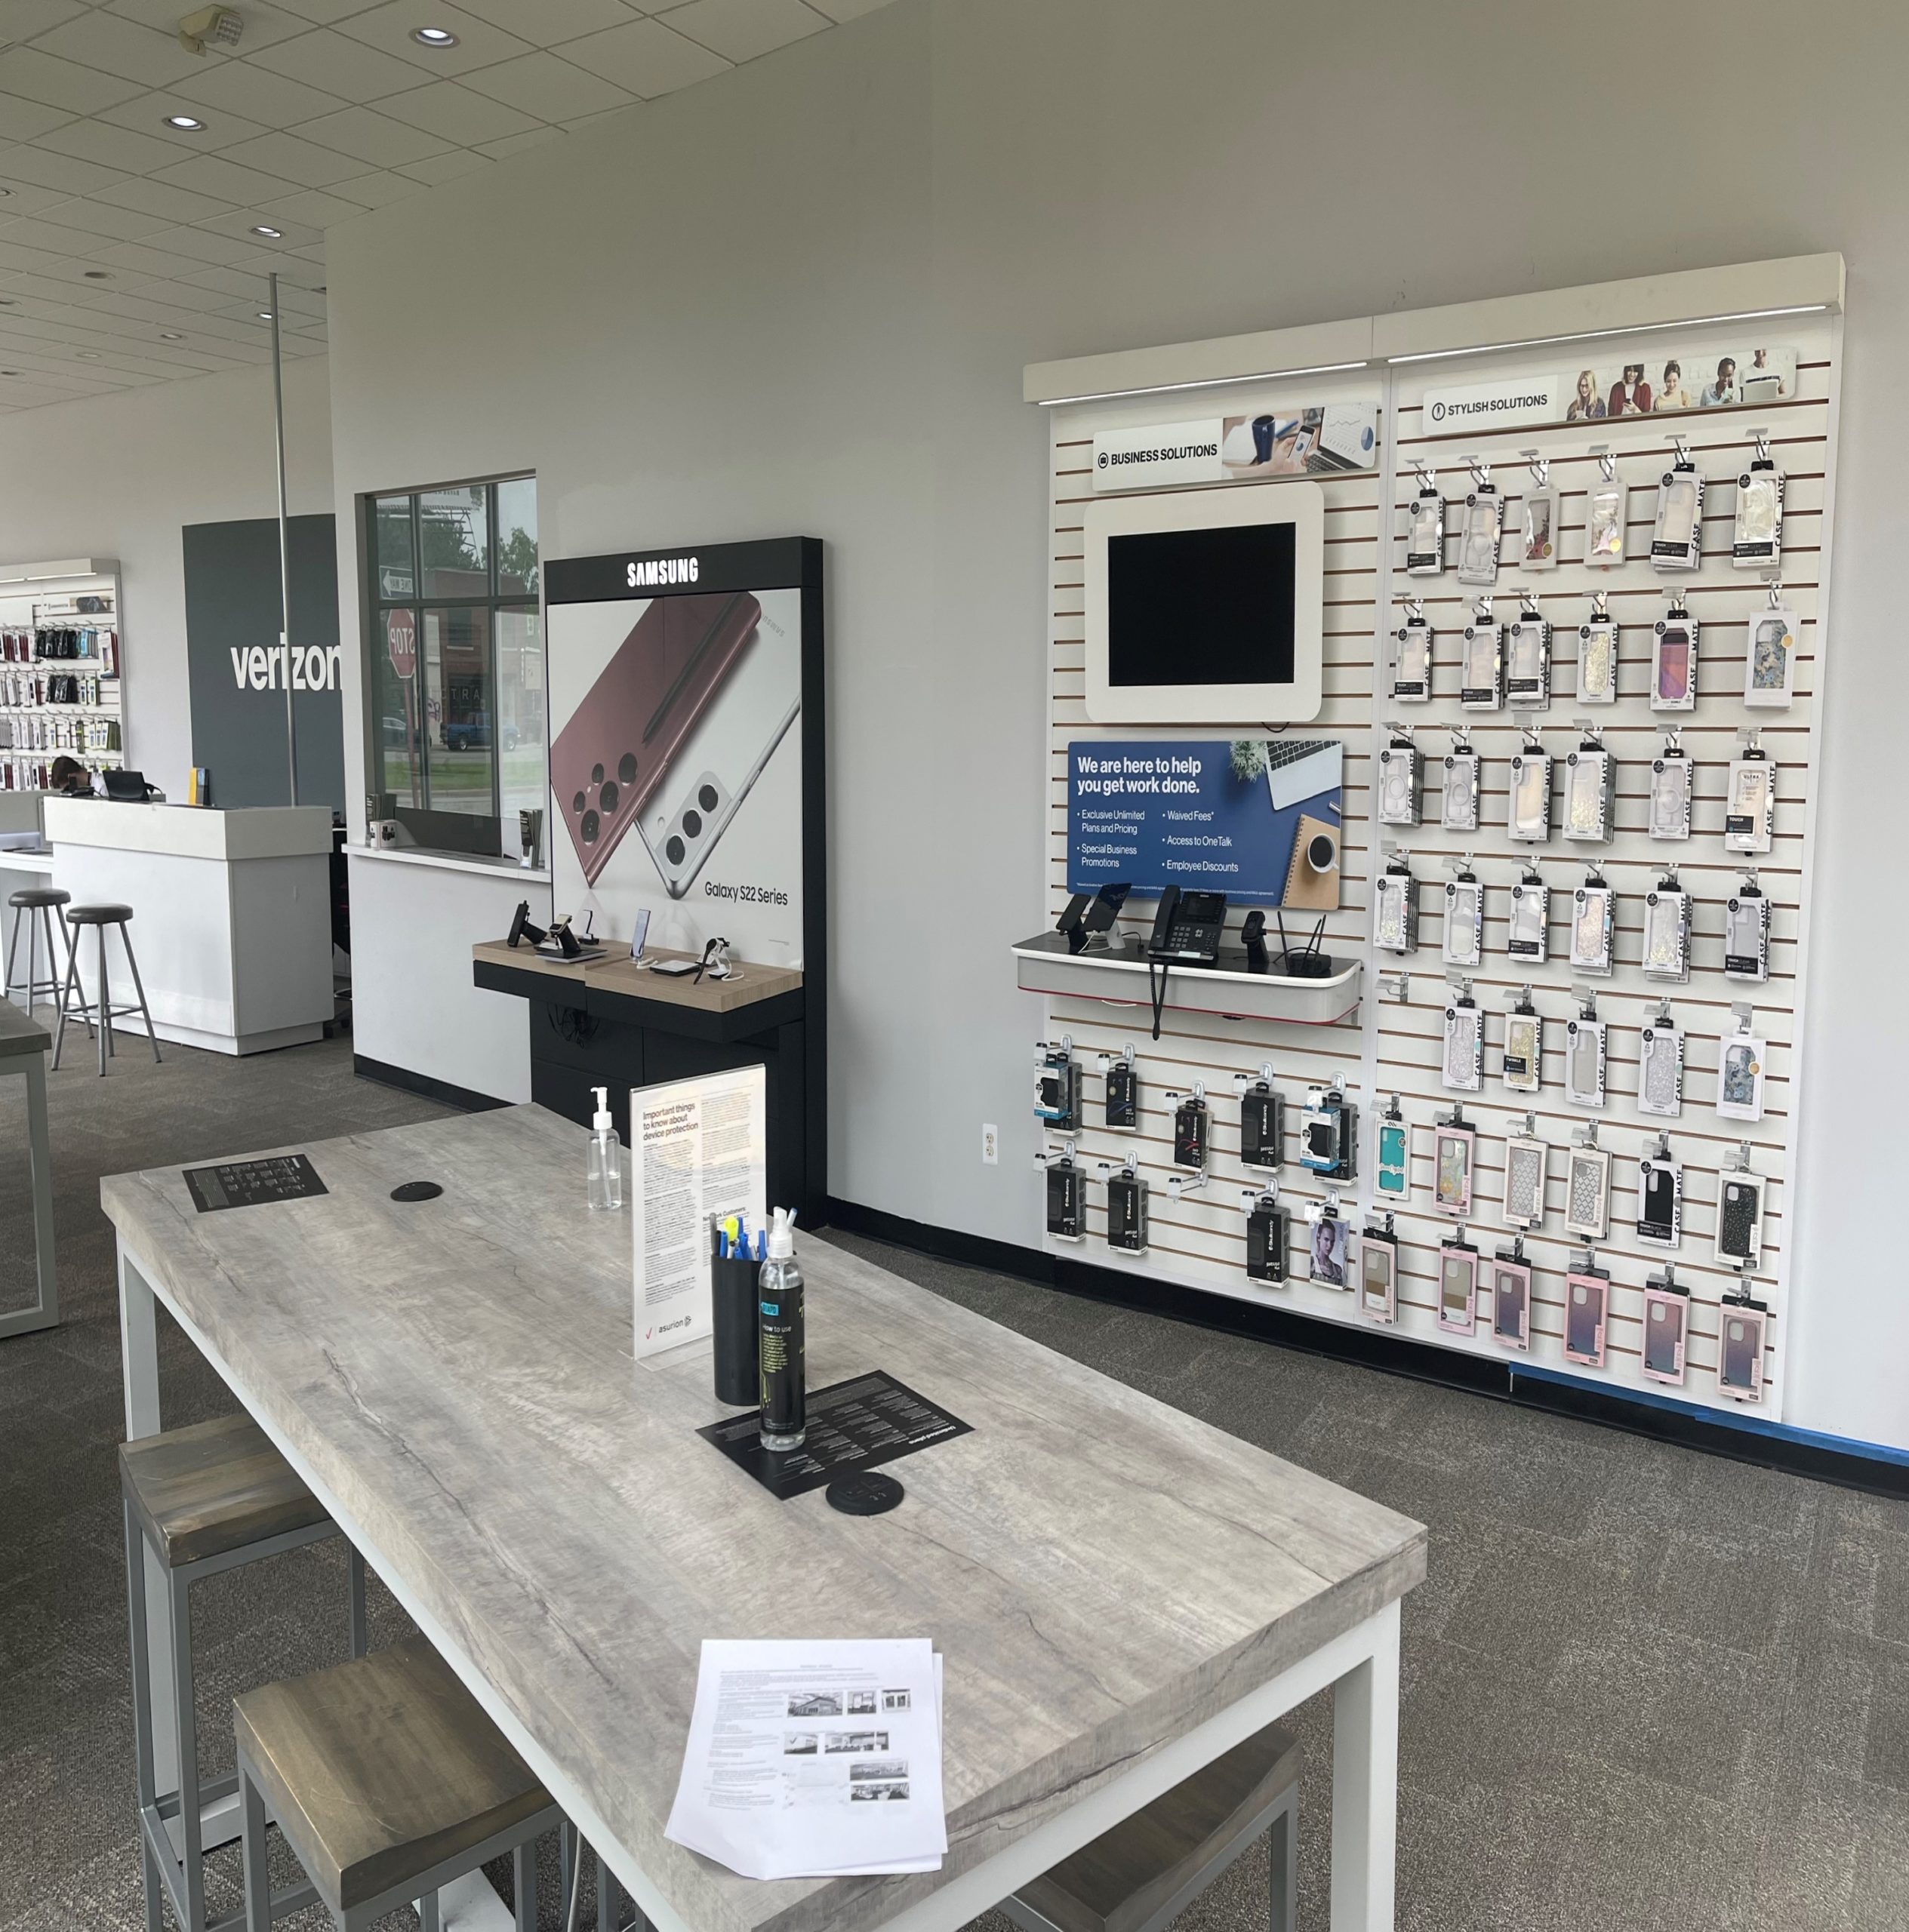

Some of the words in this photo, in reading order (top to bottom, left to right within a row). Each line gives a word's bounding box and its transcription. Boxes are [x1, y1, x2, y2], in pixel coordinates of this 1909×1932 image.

[1448, 401, 1489, 416] STYLISH
[1490, 394, 1547, 411] SOLUTIONS
[1111, 450, 1159, 466] BUSINESS
[1160, 444, 1218, 460] SOLUTIONS
[1778, 475, 1786, 503] MATE
[1691, 523, 1699, 550] CASE
[1697, 478, 1705, 507] MATE
[627, 557, 698, 587] SAMSUNG
[230, 632, 343, 691] verizon
[1077, 757, 1098, 773] We
[1101, 761, 1122, 774] are
[1123, 757, 1154, 774] here
[1156, 759, 1170, 774] to
[1172, 757, 1202, 777] help
[1077, 780, 1101, 796] you
[1103, 778, 1125, 796] get
[1126, 777, 1160, 793] work
[1162, 777, 1200, 794] done.
[1082, 810, 1113, 820] Exclusive
[1113, 811, 1145, 821] Unlimited
[1168, 810, 1193, 821] Waived
[1082, 823, 1101, 832] Plans
[1101, 824, 1113, 833] and
[1114, 824, 1138, 835] Pricing
[1082, 844, 1107, 855] Special
[1107, 845, 1138, 855] Business
[1167, 835, 1193, 846] Access
[1194, 837, 1202, 846] to
[1082, 857, 1119, 868] Promotions
[1167, 860, 1202, 872] Employee
[1202, 861, 1239, 872] Discounts
[705, 881, 738, 903] Galaxy
[741, 885, 756, 902] S22
[758, 888, 788, 906] Series
[643, 1106, 675, 1121] Important
[676, 1103, 695, 1114] things
[643, 1122, 650, 1131] to
[651, 1118, 668, 1129] know
[669, 1113, 688, 1124] about
[643, 1129, 664, 1141] device
[666, 1122, 698, 1137] protection
[658, 1318, 684, 1334] asurion
